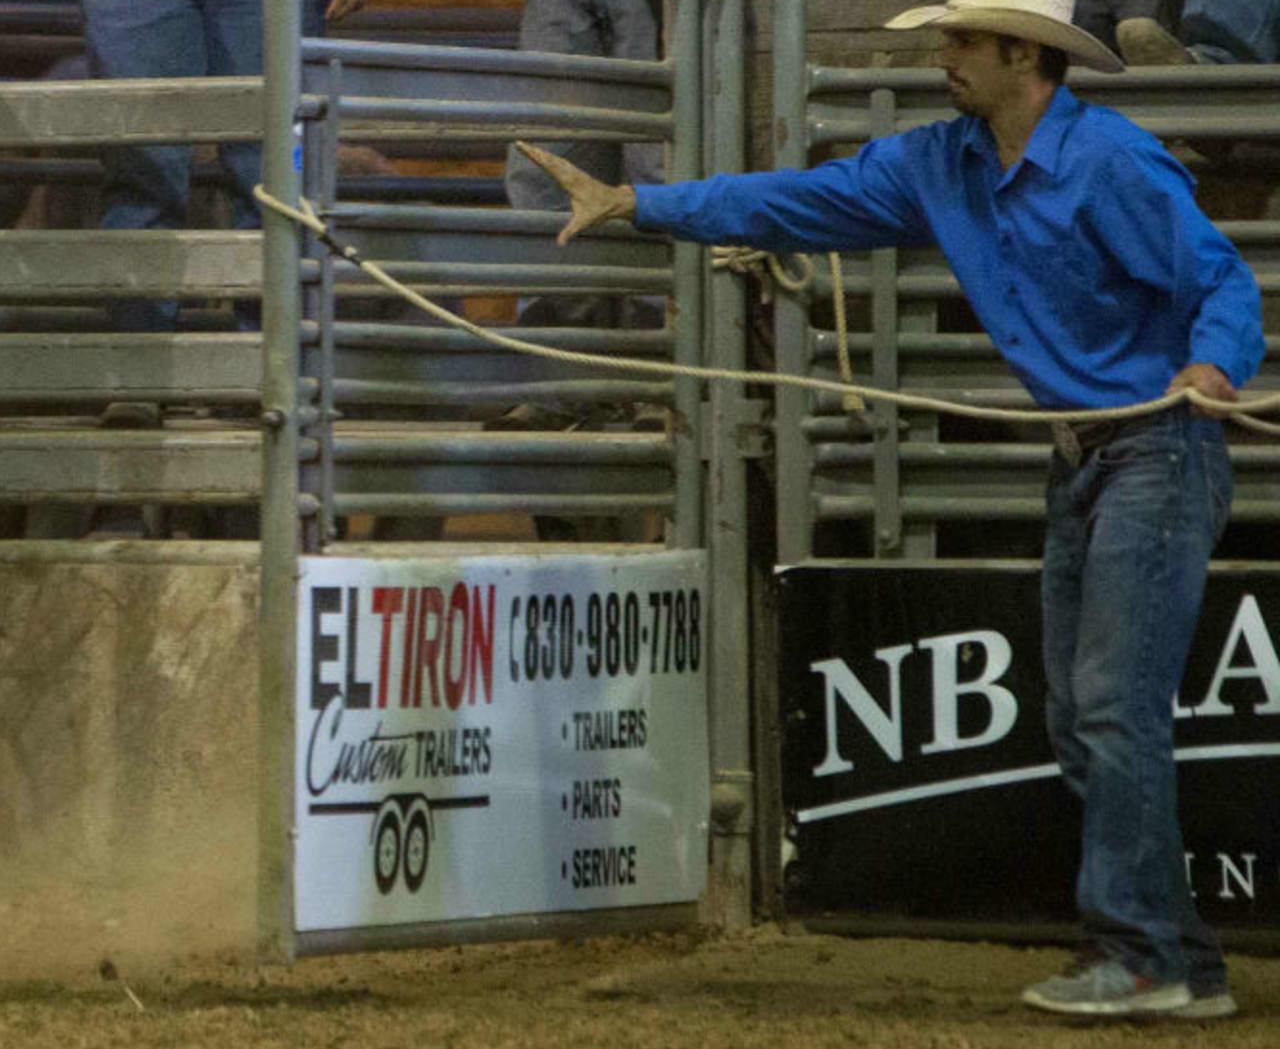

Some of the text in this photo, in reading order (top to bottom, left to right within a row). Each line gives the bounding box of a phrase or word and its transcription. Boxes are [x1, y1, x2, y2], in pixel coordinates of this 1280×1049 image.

[811, 629, 1019, 778] NB
[306, 689, 492, 796] Custom TRAILERS
[572, 709, 647, 751] TRAILERS
[572, 778, 622, 820] PARTS
[572, 846, 636, 890] SERVICE
